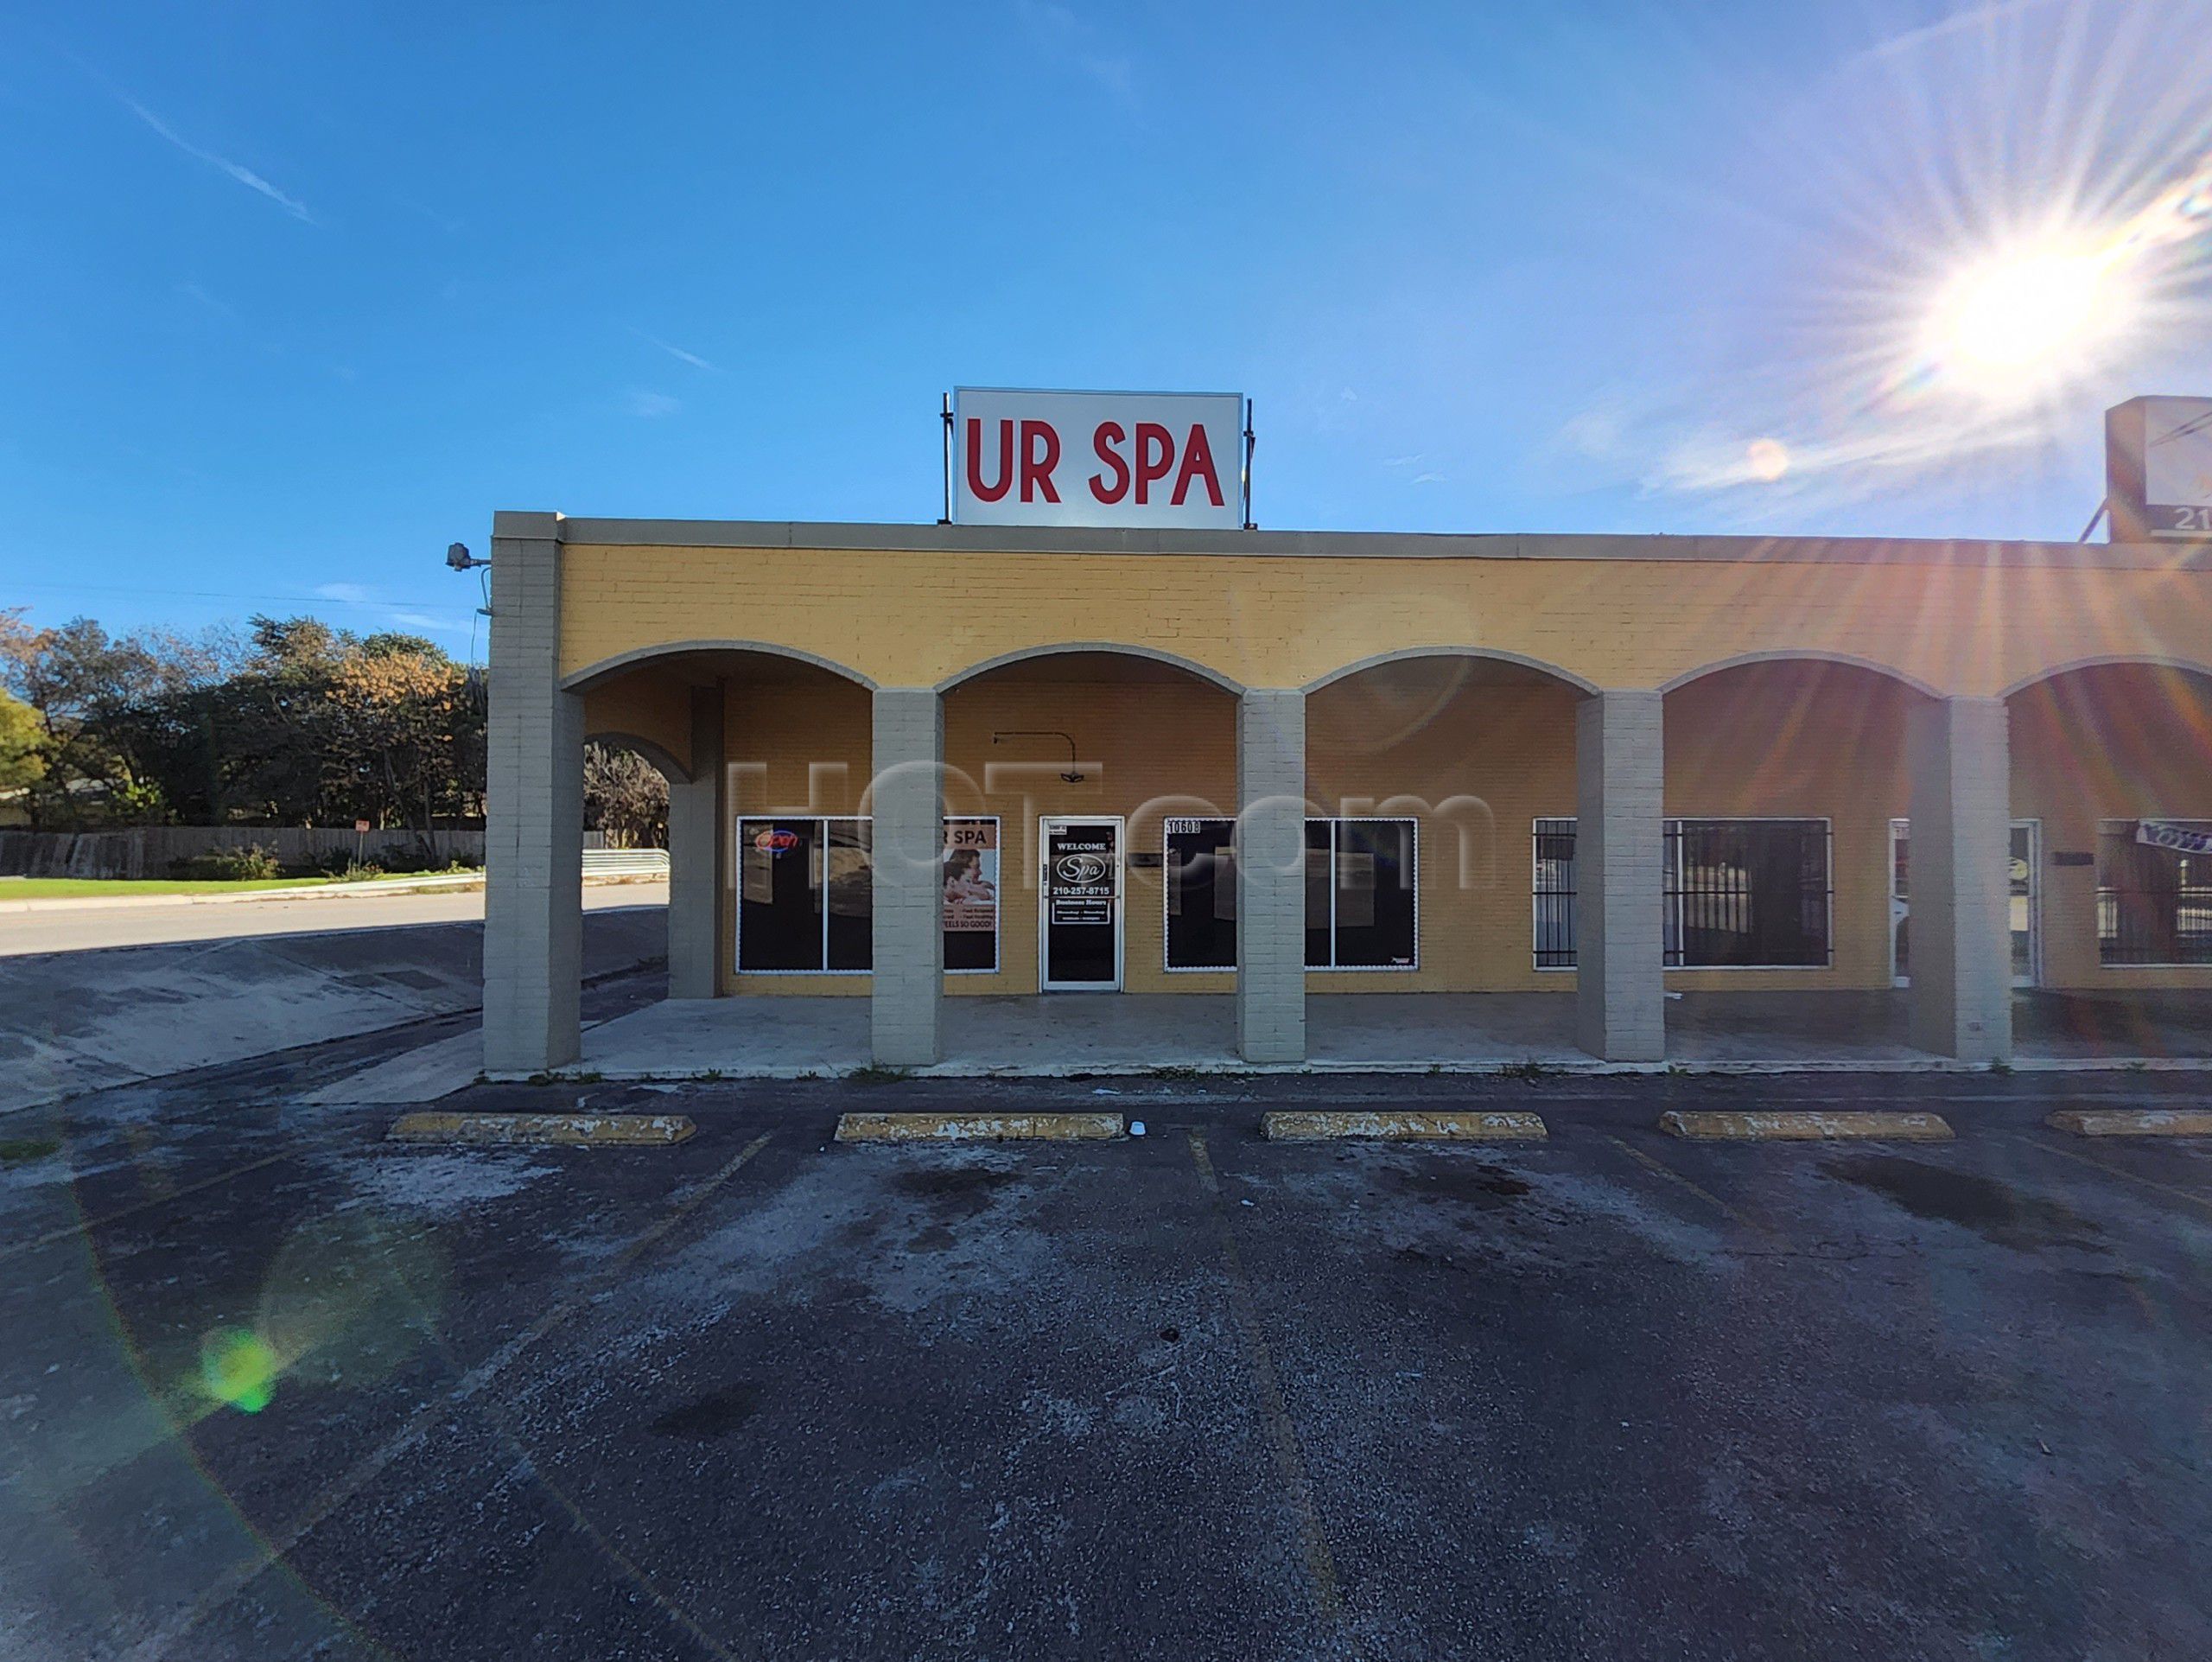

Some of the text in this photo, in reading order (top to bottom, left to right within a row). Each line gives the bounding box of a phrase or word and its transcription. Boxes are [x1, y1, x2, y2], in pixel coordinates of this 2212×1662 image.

[966, 418, 1225, 507] UR SPA
[954, 831, 987, 844] SPA
[1062, 856, 1100, 881] Spa
